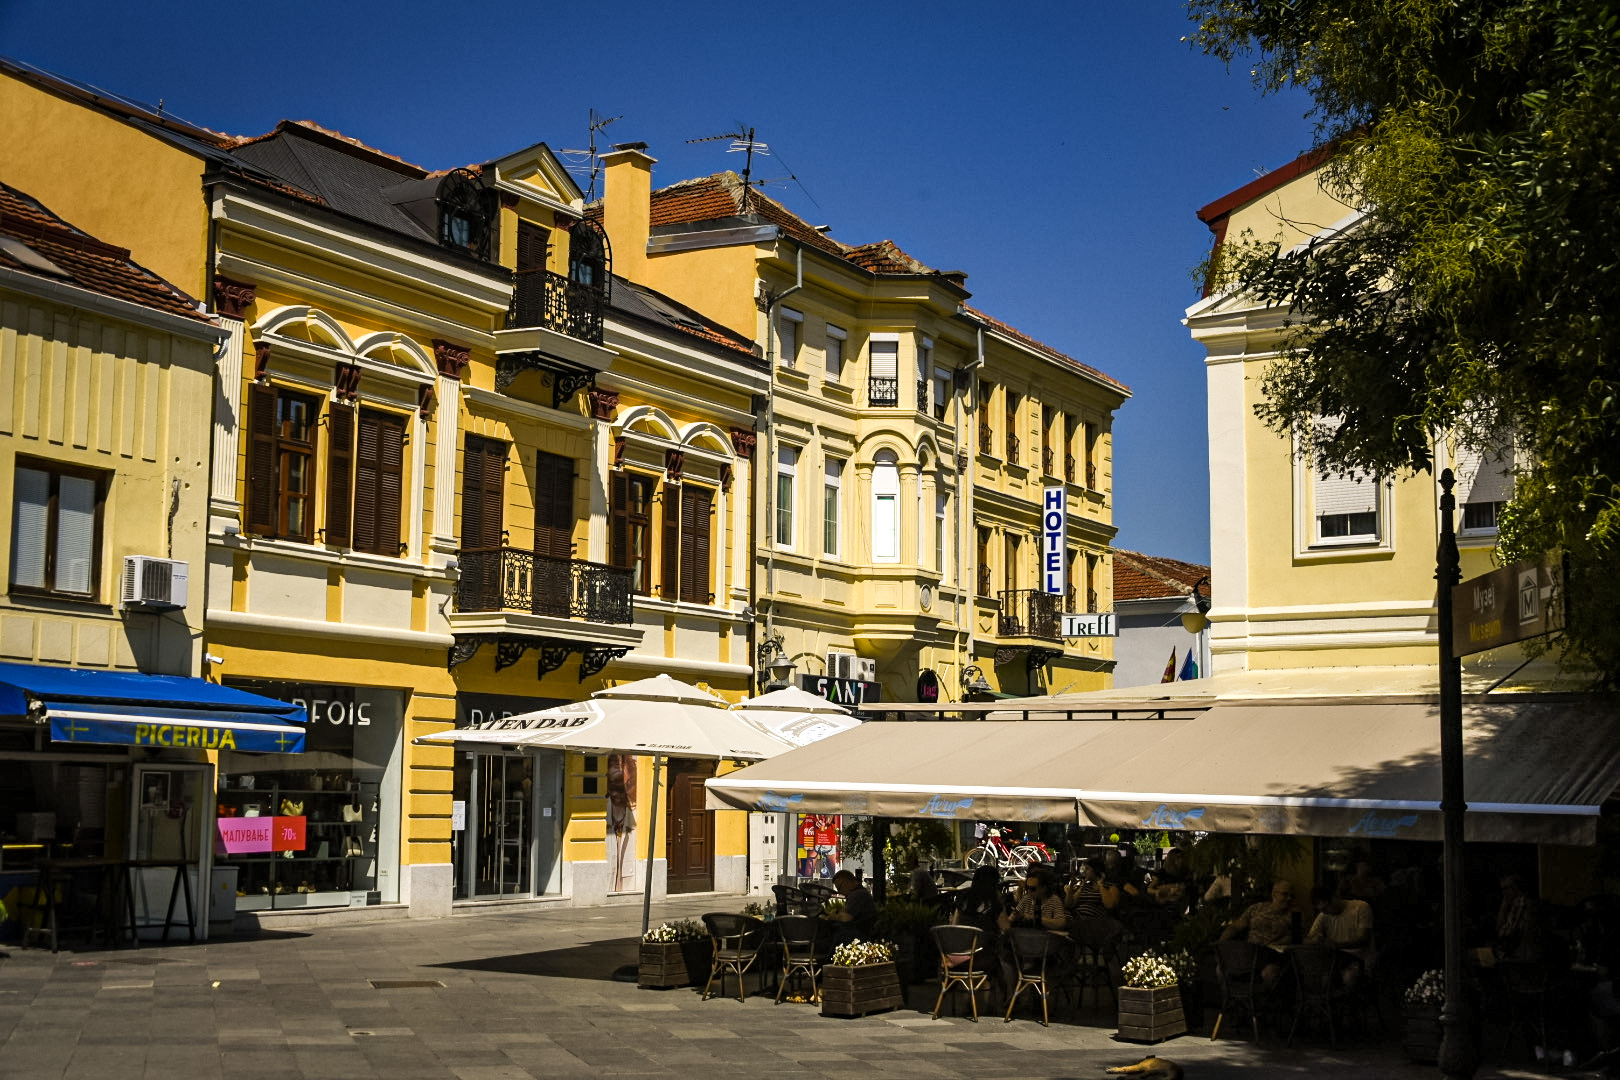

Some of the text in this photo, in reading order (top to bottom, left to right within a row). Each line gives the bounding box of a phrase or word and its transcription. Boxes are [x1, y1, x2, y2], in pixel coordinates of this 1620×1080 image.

[1045, 490, 1062, 593] HOTEL
[1473, 584, 1495, 614] Музеј
[135, 723, 236, 750] PICERIJA
[534, 717, 589, 730] DAB
